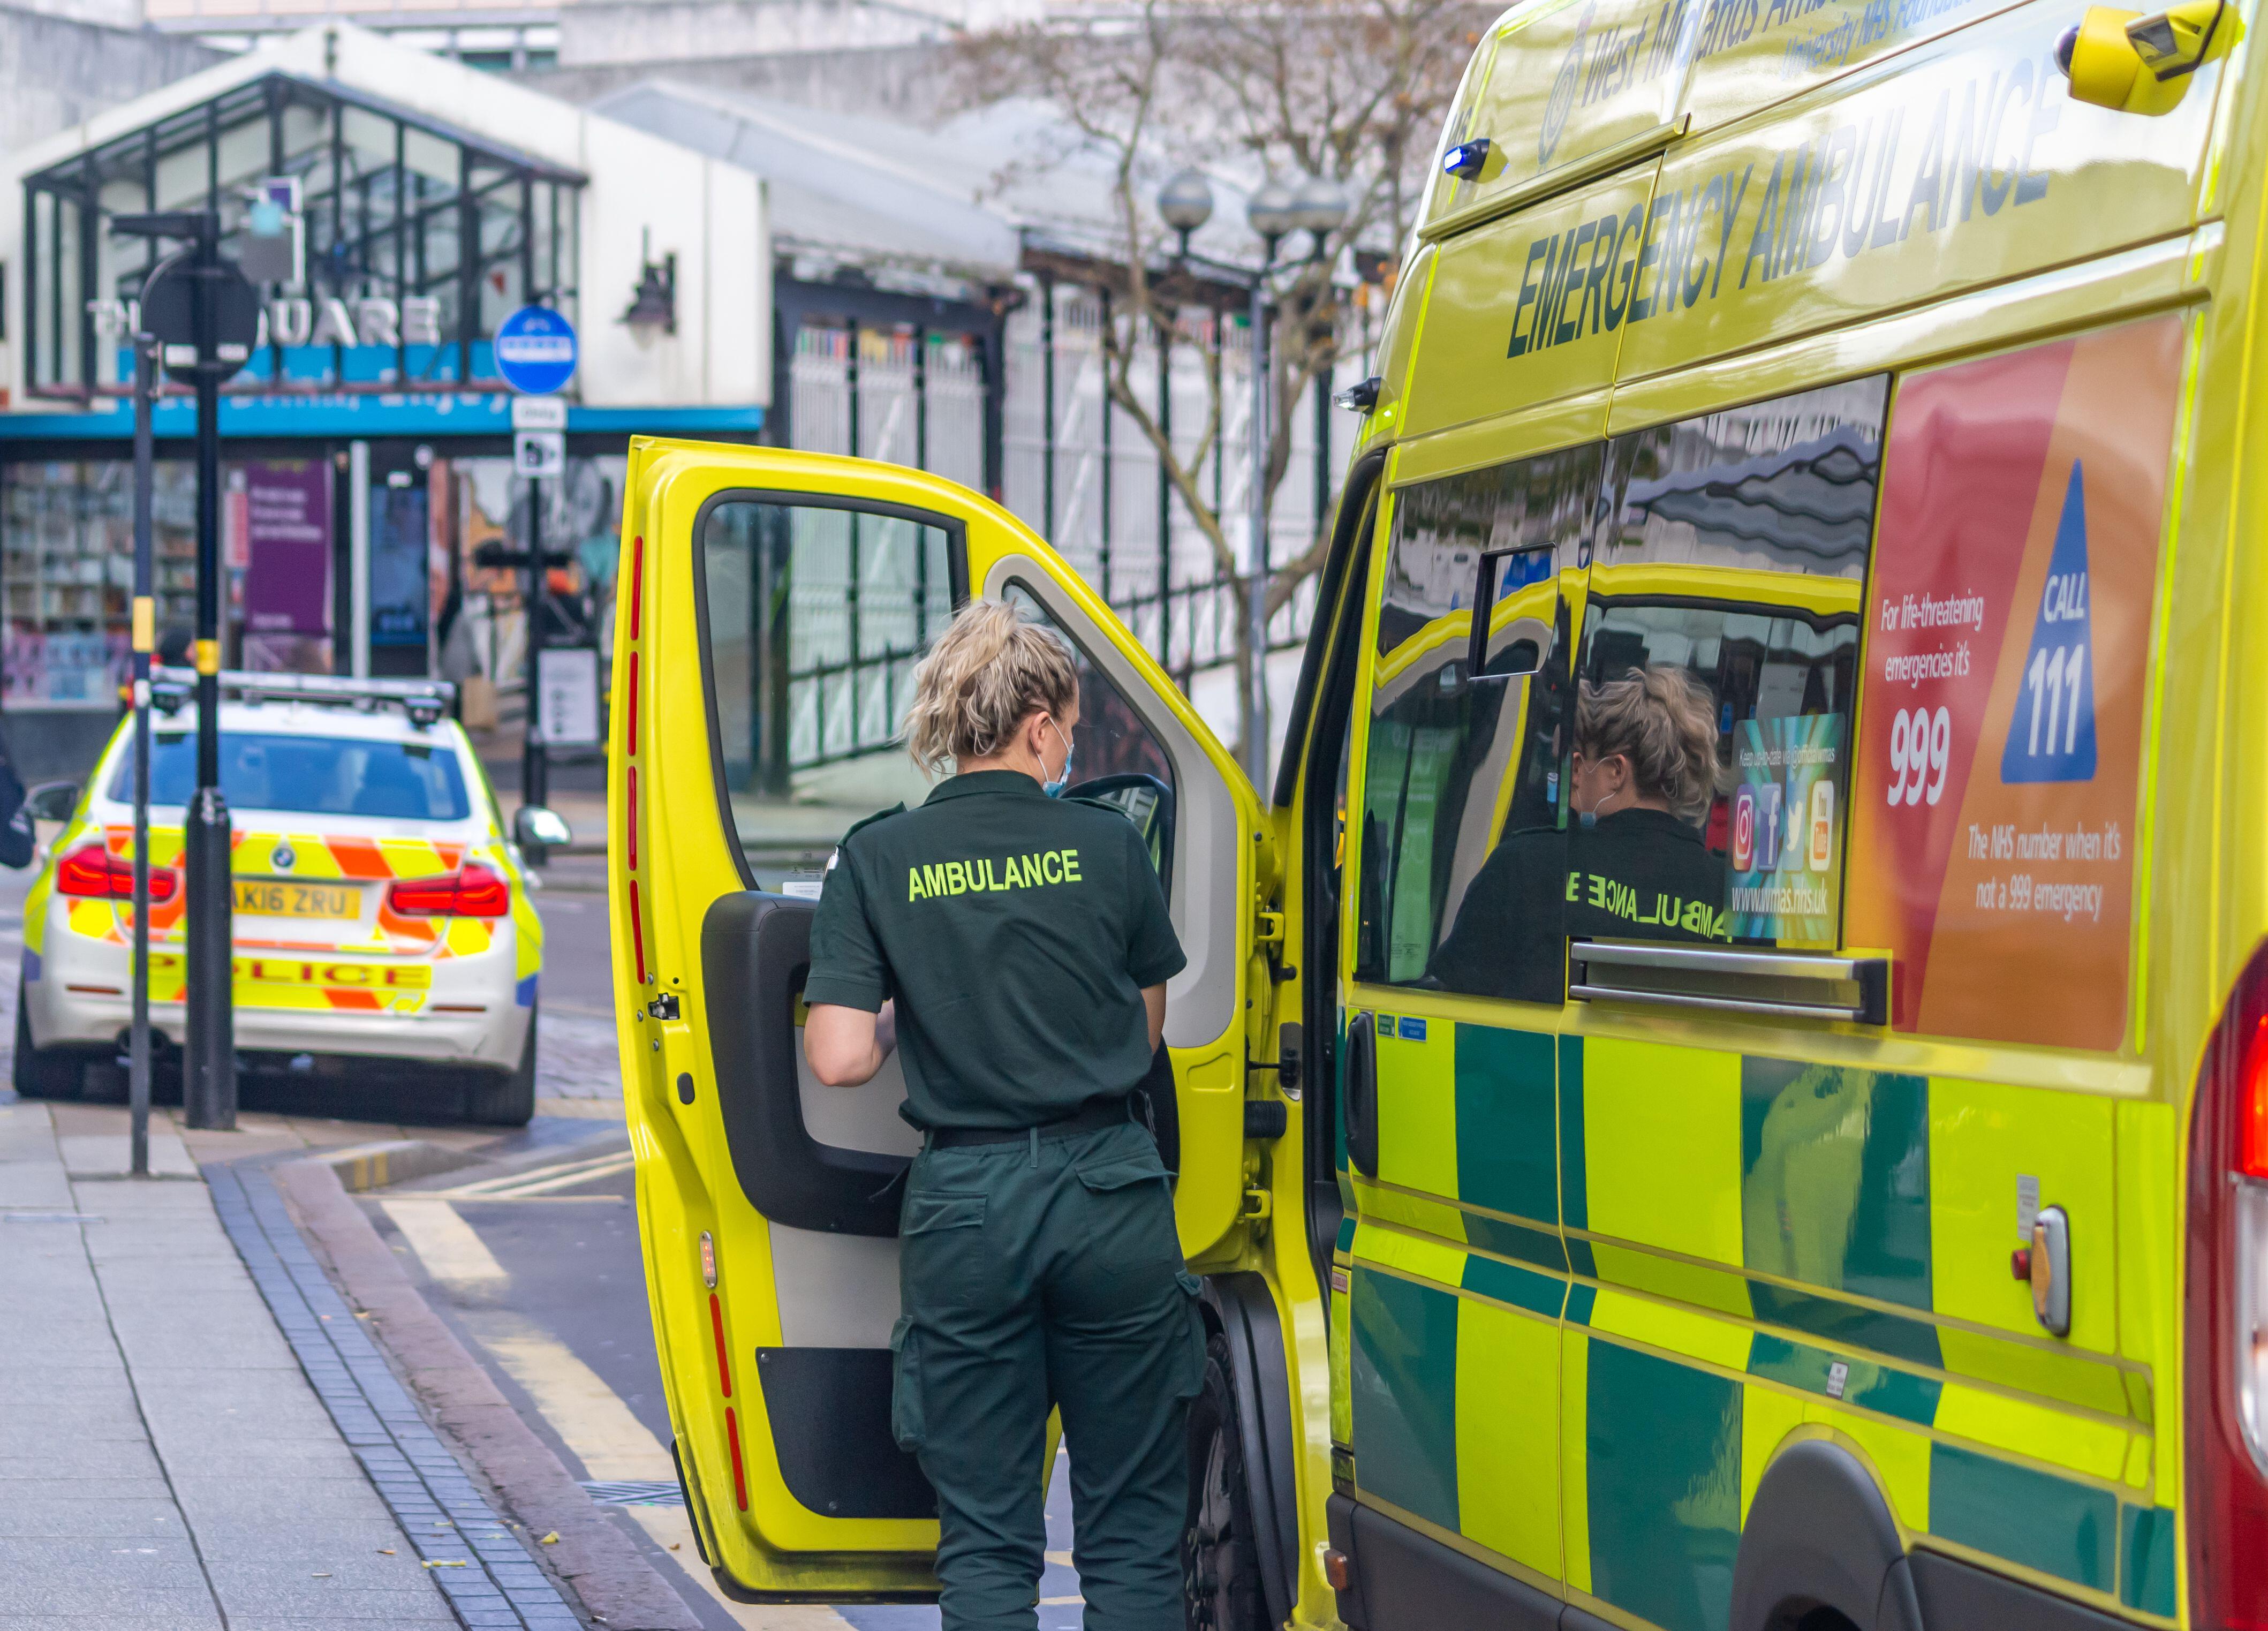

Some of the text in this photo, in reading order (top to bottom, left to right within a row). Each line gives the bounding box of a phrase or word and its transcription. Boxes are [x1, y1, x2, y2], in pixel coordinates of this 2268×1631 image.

[1581, 12, 1650, 108] West
[1781, 11, 1859, 81] University
[1856, 0, 1890, 49] NHS
[1507, 52, 2061, 358] EMERGENCY AMBULANCE
[86, 296, 441, 349] TH UARE
[1881, 588, 1984, 631] For life-threatening
[2044, 572, 2085, 623] CALL
[1885, 640, 1970, 689] emergencies it's
[2028, 644, 2084, 756] 111
[1740, 747, 1753, 769] Keep
[1754, 747, 1781, 769] up-to-date
[1782, 749, 1791, 764] via
[1887, 706, 1951, 805] 999
[1817, 791, 1827, 816] You
[1815, 828, 1827, 854] Tube
[1968, 821, 2121, 860] The NHS number when it's
[909, 849, 1082, 902] AMBULANCE
[1732, 877, 1827, 915] www.wmas.nhs.uk
[1976, 873, 2103, 922] not a 999 emergency
[293, 889, 346, 915] ZRU
[148, 954, 425, 986] PLICE
